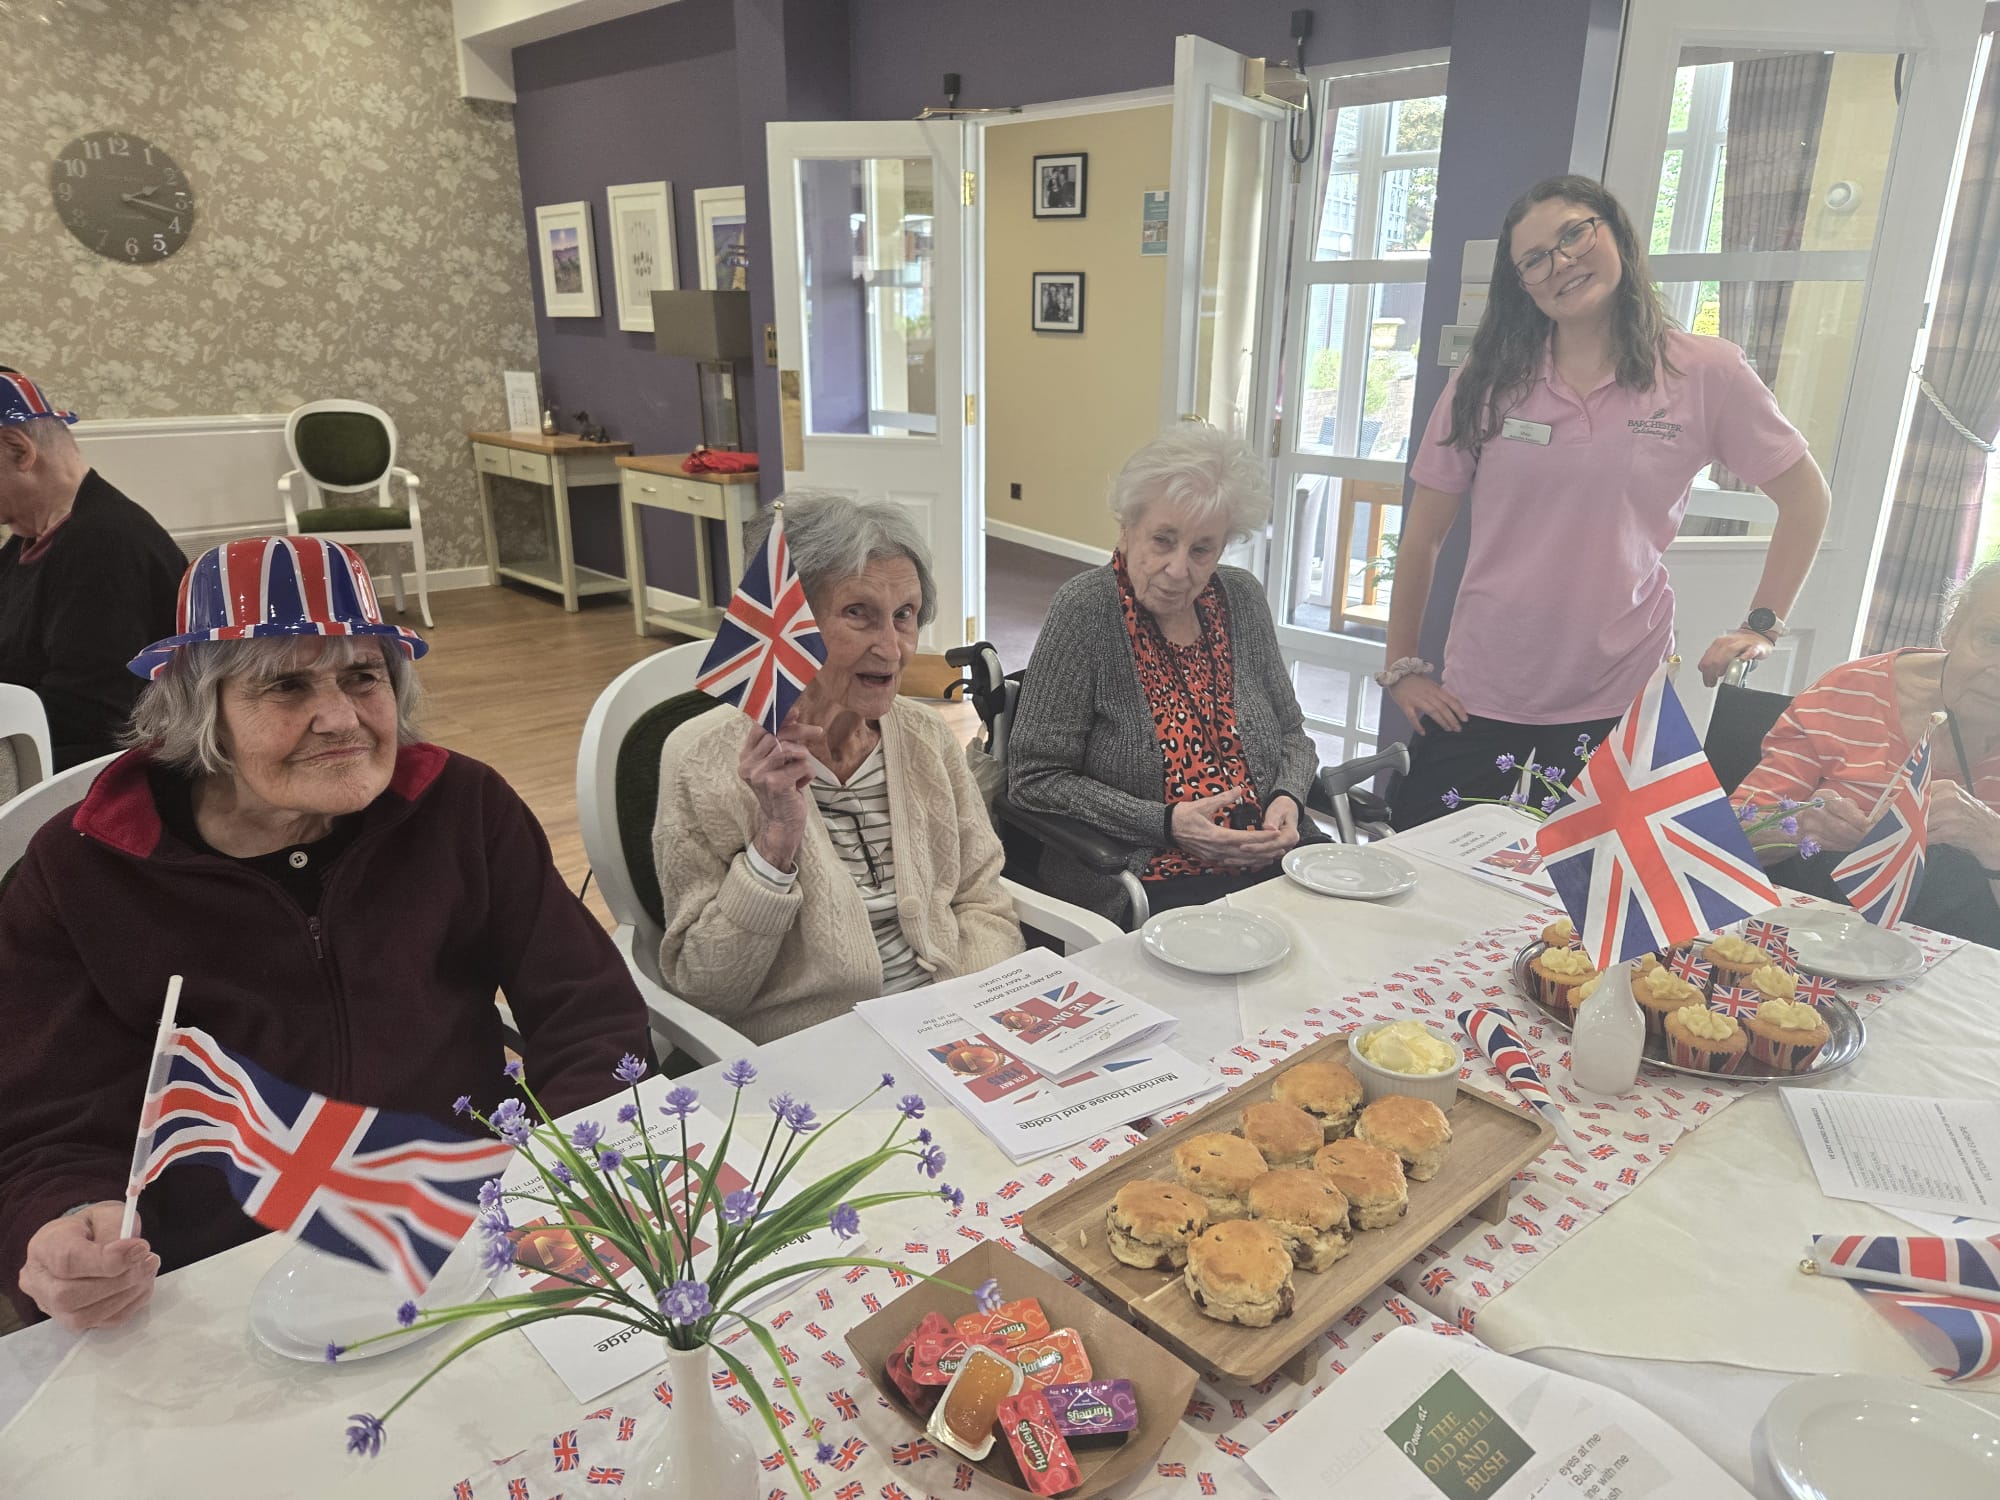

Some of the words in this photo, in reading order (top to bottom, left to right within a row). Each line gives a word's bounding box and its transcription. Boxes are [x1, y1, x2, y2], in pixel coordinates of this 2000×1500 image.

[82, 140, 101, 160] 11
[107, 137, 130, 157] 12
[143, 147, 153, 166] 1
[63, 158, 87, 178] 10
[164, 167, 177, 186] 2
[58, 182, 73, 202] 9
[167, 216, 181, 234] 4
[125, 237, 139, 256] 6
[153, 233, 166, 251] 5
[1627, 419, 1684, 432] BARCHESTER
[1002, 968, 1023, 980] GOOD
[1029, 976, 1046, 988] AND
[1046, 969, 1063, 980] QUIZ
[1005, 983, 1030, 996] PUZZLE
[973, 992, 1006, 1009] BOOKLET
[1069, 1002, 1091, 1013] VE
[1047, 1011, 1075, 1026] DAY
[999, 1080, 1016, 1090] MAY
[1132, 1073, 1179, 1094] Marriott
[1090, 1089, 1131, 1107] House
[1064, 1102, 1088, 1118] and
[657, 1123, 678, 1137] Join
[1019, 1113, 1063, 1131] Lodge
[628, 1141, 643, 1150] for
[597, 1318, 651, 1353] odge
[1018, 1350, 1063, 1375] Hartley's
[1066, 1406, 1114, 1420] Hartley's
[1403, 1423, 1424, 1457] Down
[1418, 1404, 1429, 1422] at
[1426, 1411, 1461, 1442] THE
[1019, 1420, 1048, 1471] Hartley's
[1424, 1442, 1457, 1475] OLD
[1453, 1410, 1495, 1448] BULL
[1455, 1439, 1491, 1475] AND
[1558, 1454, 1580, 1477] eyes
[1577, 1444, 1591, 1458] at
[1585, 1432, 1602, 1449] me
[1465, 1448, 1511, 1494] BUSH
[1571, 1462, 1598, 1486] Bush
[1596, 1466, 1617, 1487] with
[1613, 1453, 1630, 1471] me
